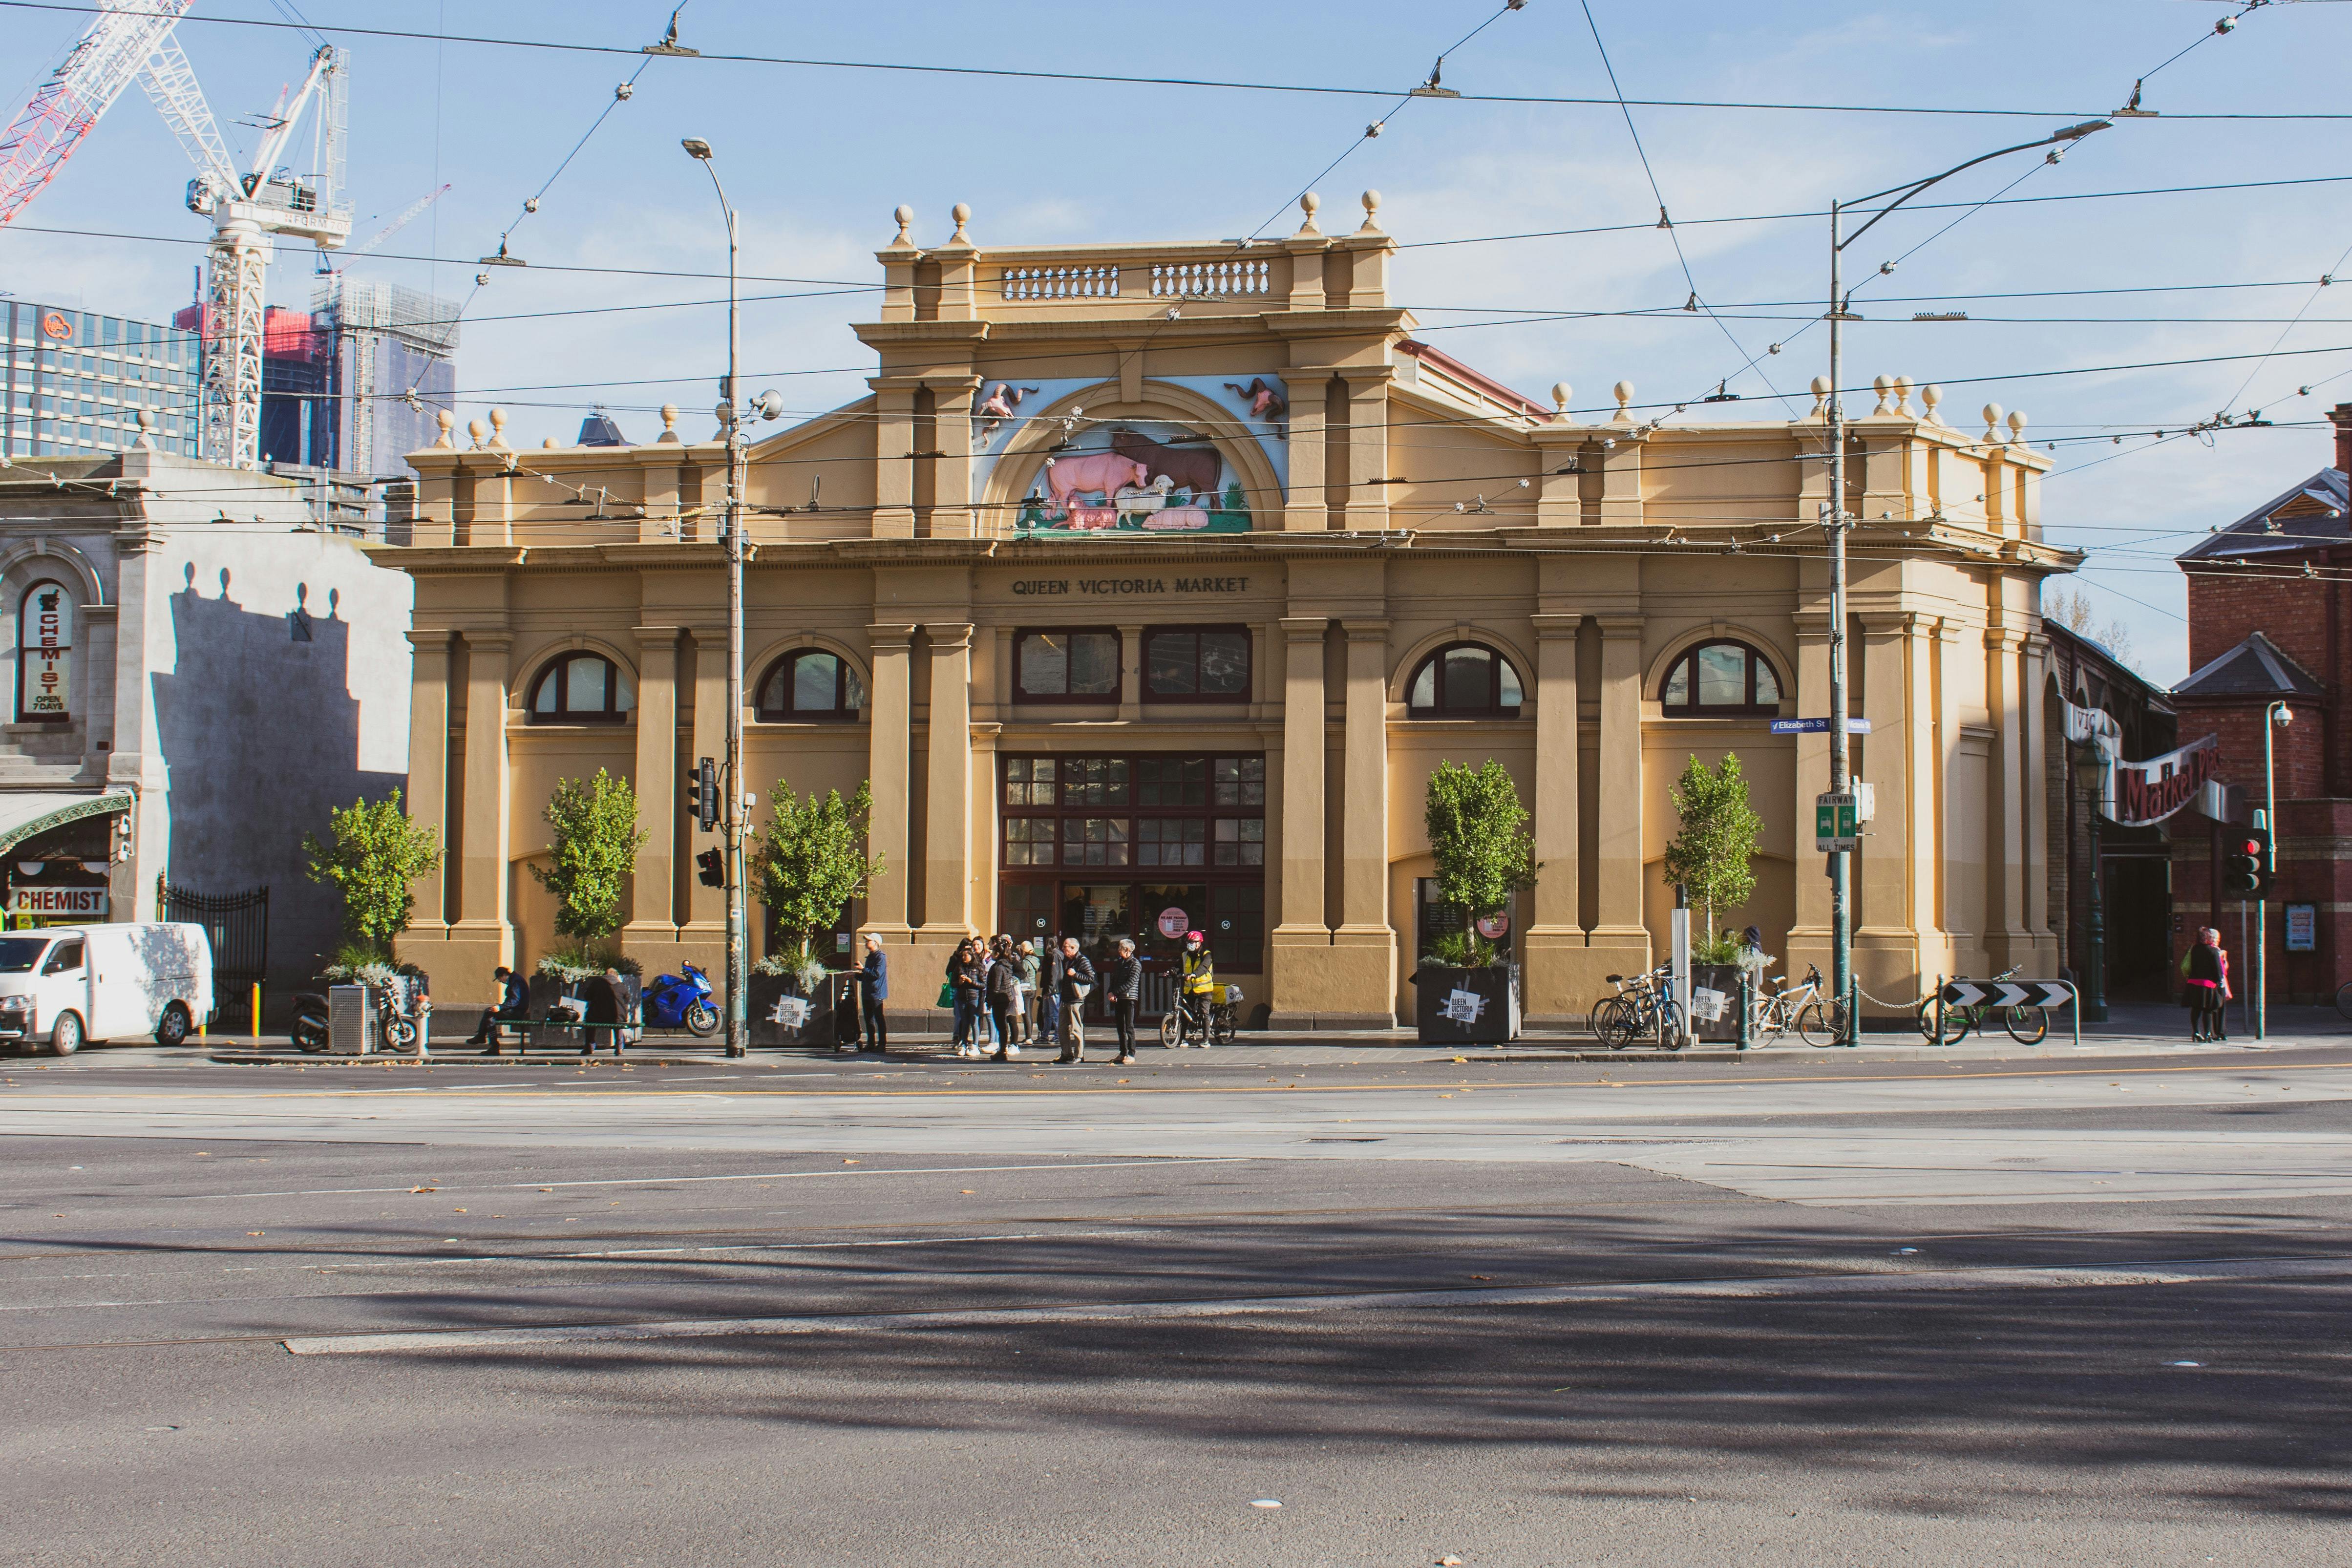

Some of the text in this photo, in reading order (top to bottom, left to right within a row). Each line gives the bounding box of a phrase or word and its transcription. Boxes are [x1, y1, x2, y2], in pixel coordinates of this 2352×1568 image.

[295, 215, 350, 232] FORM 700
[1013, 577, 1249, 595] QUEEN VICTORIA MARKET
[40, 613, 61, 694] CHEMIST
[1779, 720, 1825, 729] Elizabeth St
[1819, 795, 1854, 805] FAIRWAY
[2119, 761, 2194, 822] Market
[18, 890, 103, 911] CHEMIST
